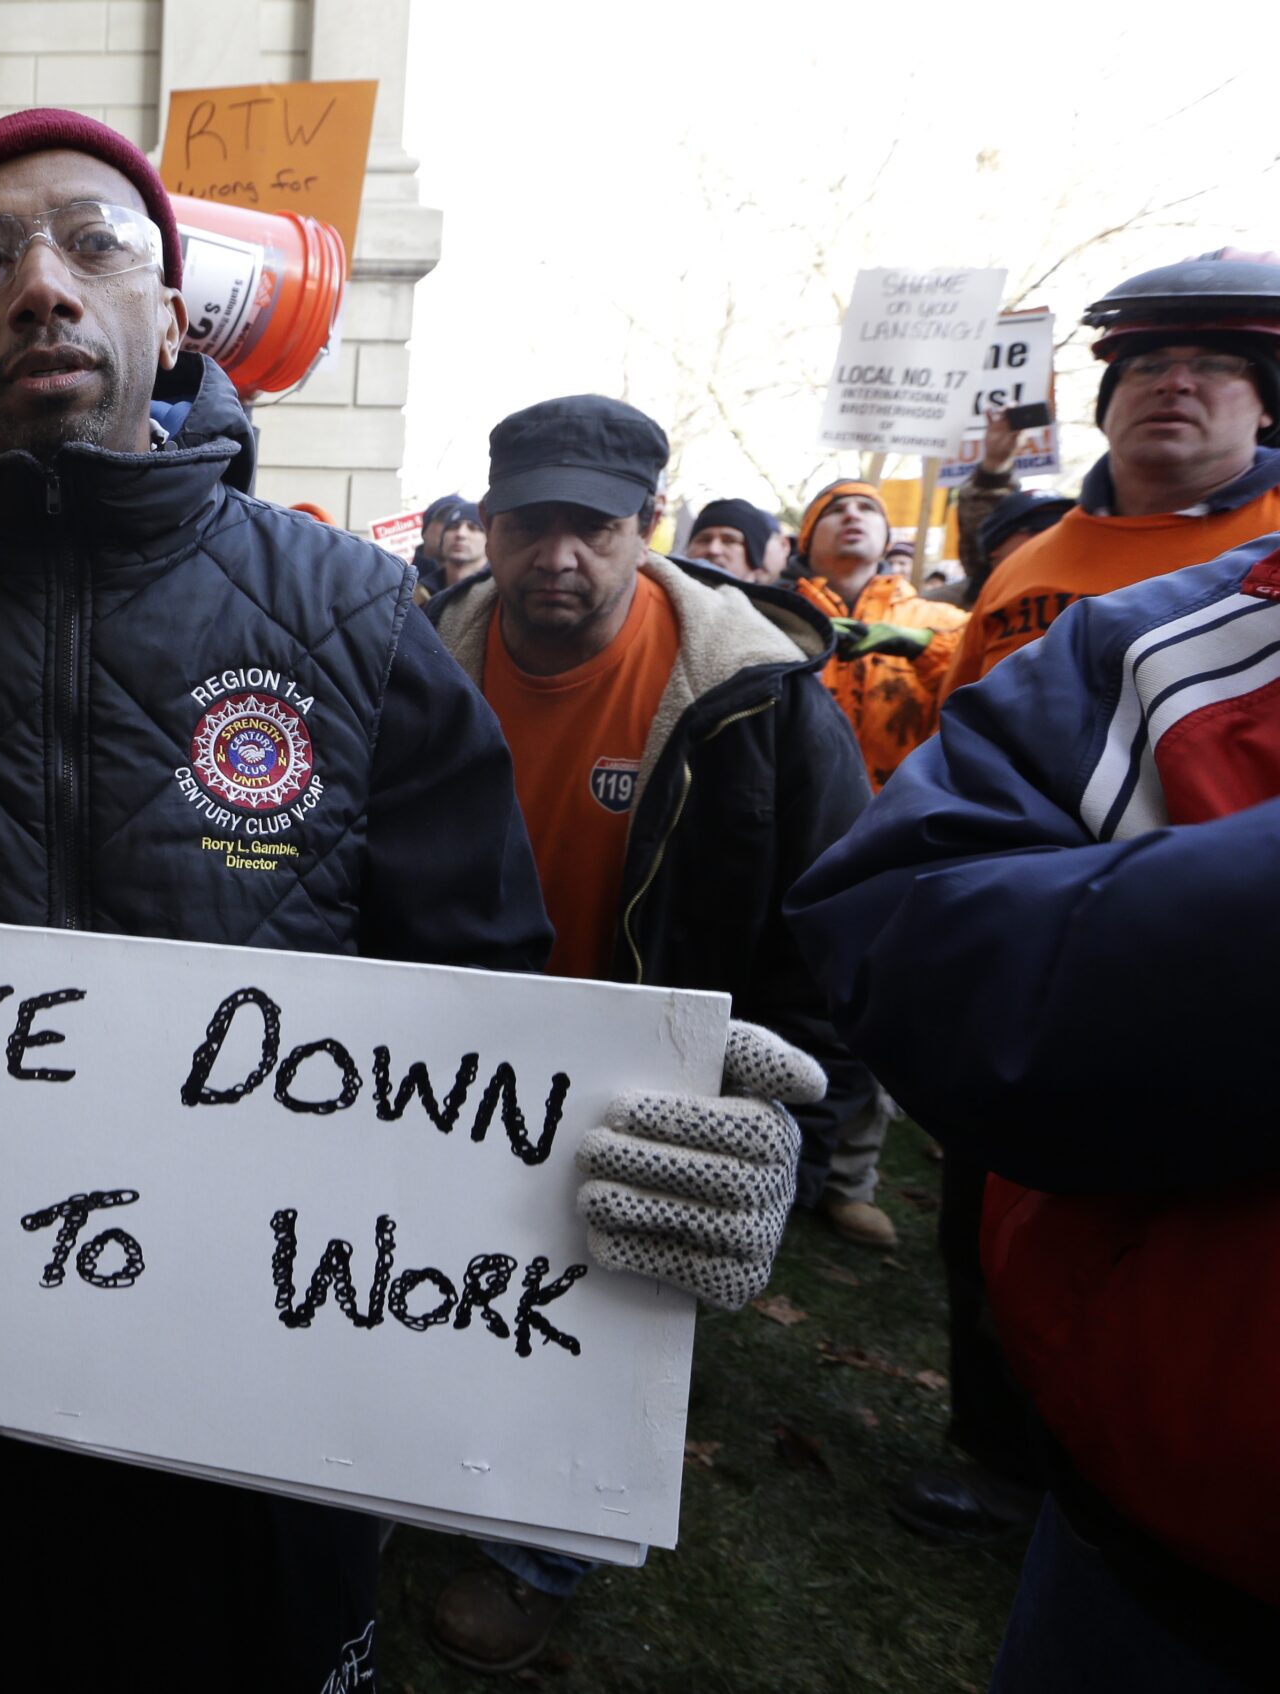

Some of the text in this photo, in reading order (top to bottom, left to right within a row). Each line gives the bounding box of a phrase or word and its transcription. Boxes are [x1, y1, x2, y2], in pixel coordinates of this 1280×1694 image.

[184, 96, 337, 171] RTW
[270, 167, 319, 193] for
[882, 271, 969, 298] SHAME
[859, 317, 987, 342] LANSING!
[836, 364, 970, 390] LOCAL NO. 17
[190, 668, 315, 715] REGION 1-A
[221, 718, 284, 743] STRENGTH
[230, 731, 273, 752] CENTURY
[217, 744, 226, 763] IN
[278, 748, 287, 767] IN
[232, 773, 271, 787] UNITY
[237, 763, 267, 775] CLUB
[596, 772, 633, 802] 119
[175, 766, 324, 835] CENTURY CLUB V-CAP
[202, 836, 300, 858] Rory L. Gamble,
[226, 855, 278, 870] Director
[180, 986, 571, 1166] DOWN
